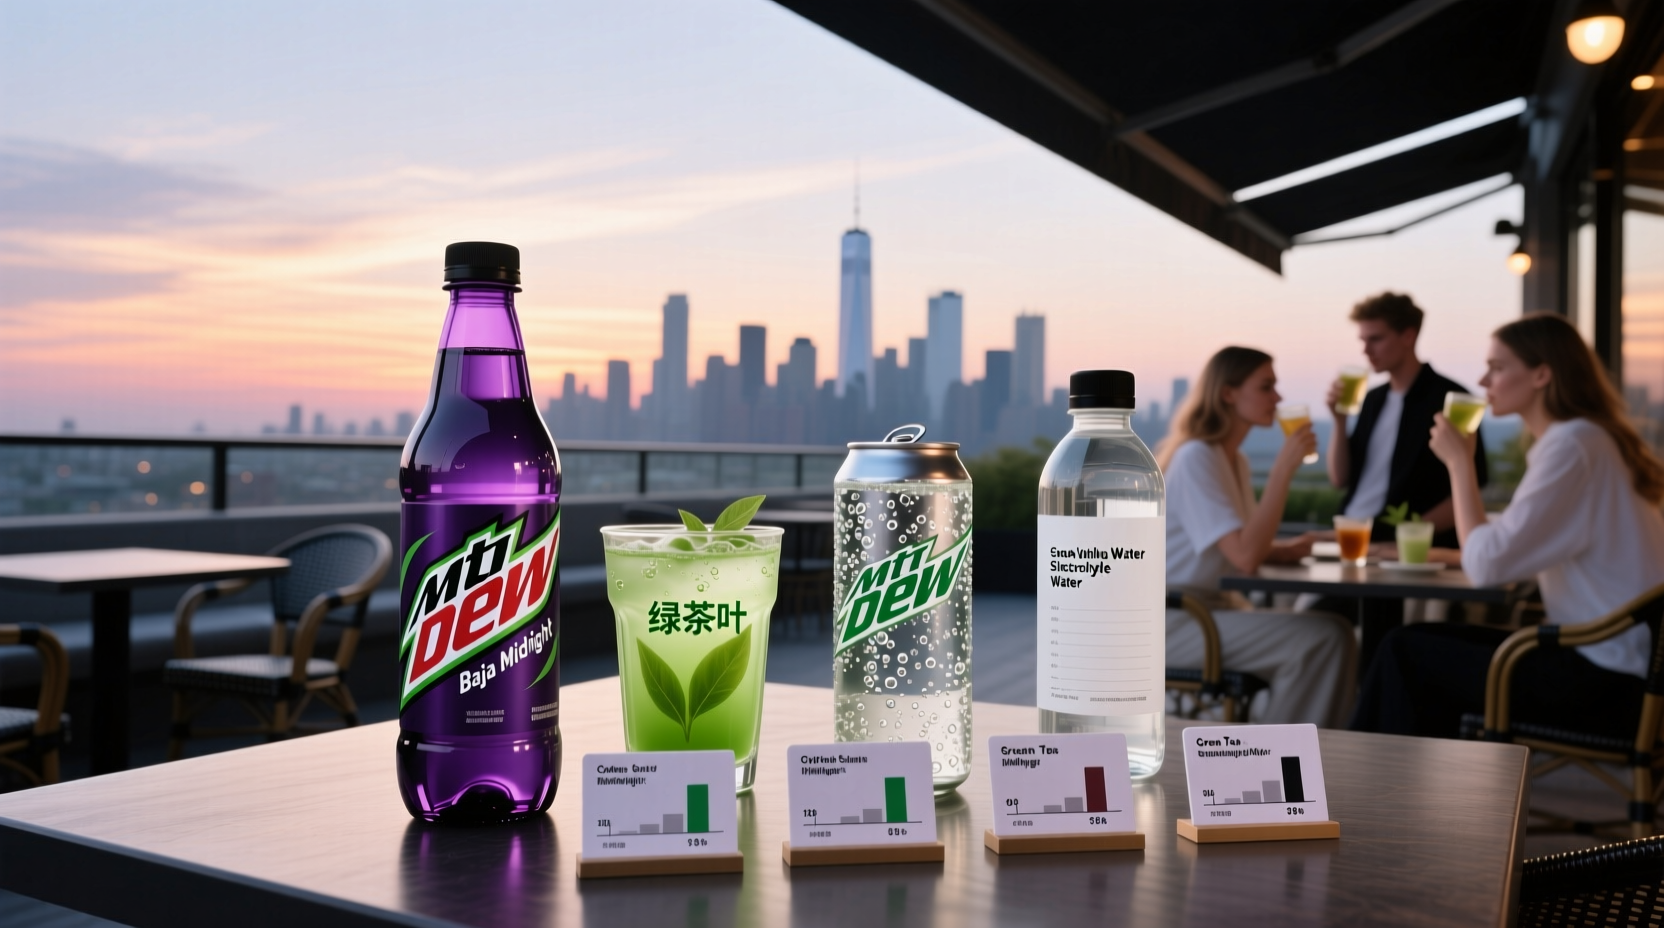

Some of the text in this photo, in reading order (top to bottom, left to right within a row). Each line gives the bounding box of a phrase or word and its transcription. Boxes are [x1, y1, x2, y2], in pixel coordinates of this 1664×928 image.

[1110, 546, 1146, 560] Water
[1050, 575, 1083, 588] Water
[648, 599, 748, 636] 绿茶叶
[459, 662, 497, 695] Baja
